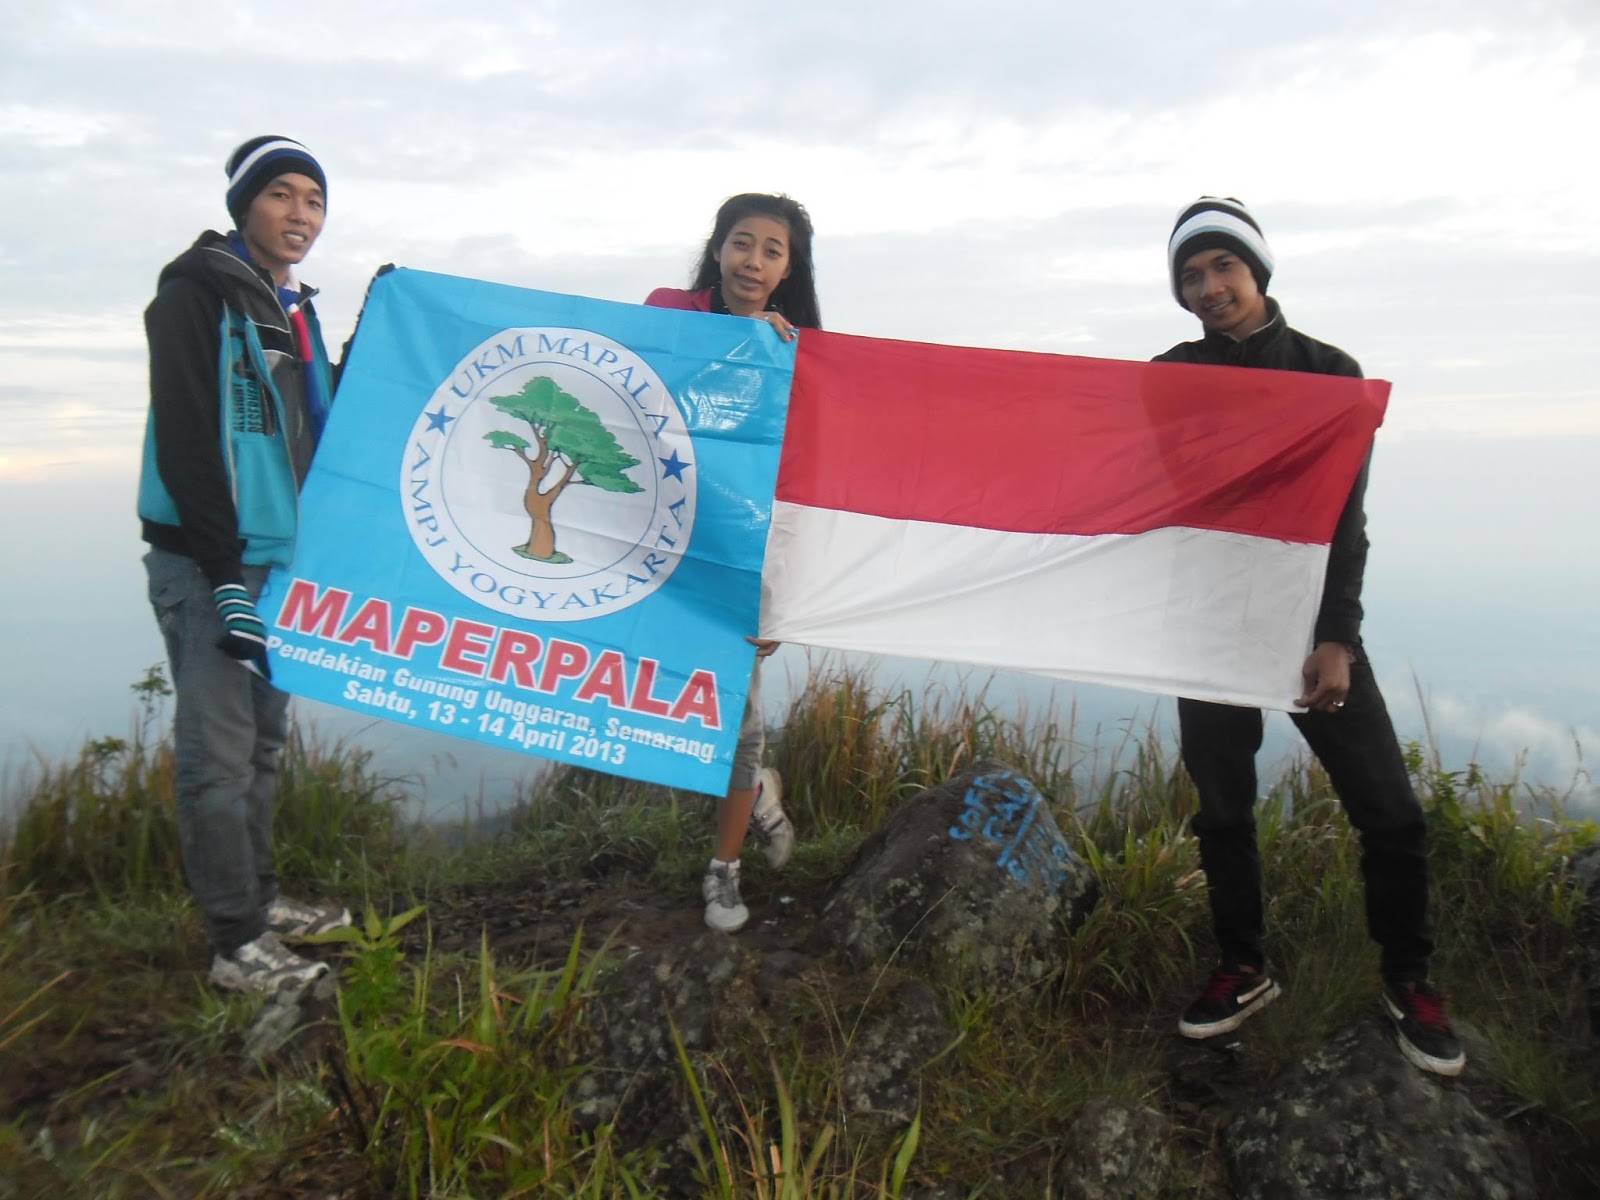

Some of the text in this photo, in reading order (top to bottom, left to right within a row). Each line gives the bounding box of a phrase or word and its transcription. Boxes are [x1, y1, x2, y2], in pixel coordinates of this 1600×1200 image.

[450, 333, 670, 440] UKM MAPALA
[447, 496, 686, 610] YOGYAKARTA
[266, 635, 715, 764] Pendakian Gunung Unggaran, Semarang
[275, 577, 722, 730] MAPERPALA
[343, 680, 417, 719] Sabtu,
[428, 701, 456, 724] 13
[478, 713, 505, 736] 14
[508, 721, 566, 751] April
[569, 735, 626, 765] 2013
